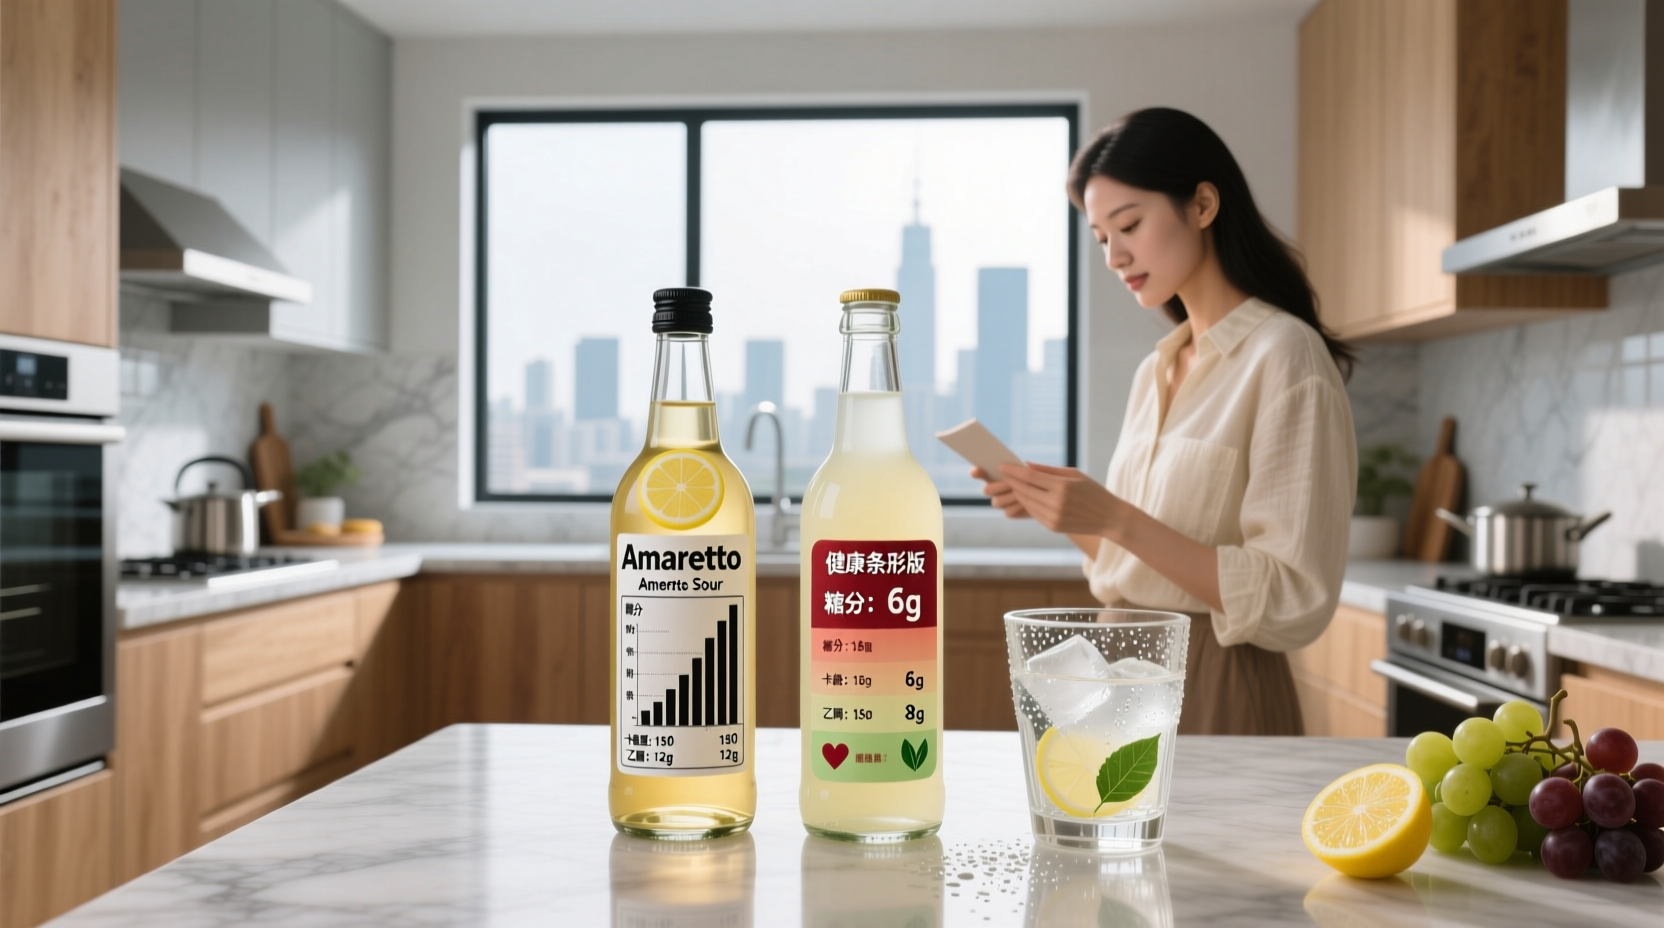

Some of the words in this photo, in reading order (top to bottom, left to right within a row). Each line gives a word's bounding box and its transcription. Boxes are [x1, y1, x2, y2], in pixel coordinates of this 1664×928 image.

[621, 544, 741, 571] Amaretto
[825, 551, 926, 575] 健康条形版
[692, 577, 724, 591] Sour
[887, 587, 922, 622] 6g
[905, 671, 924, 691] 6g
[904, 704, 924, 725] 8g
[655, 735, 675, 747] 150
[654, 751, 674, 767] 12g
